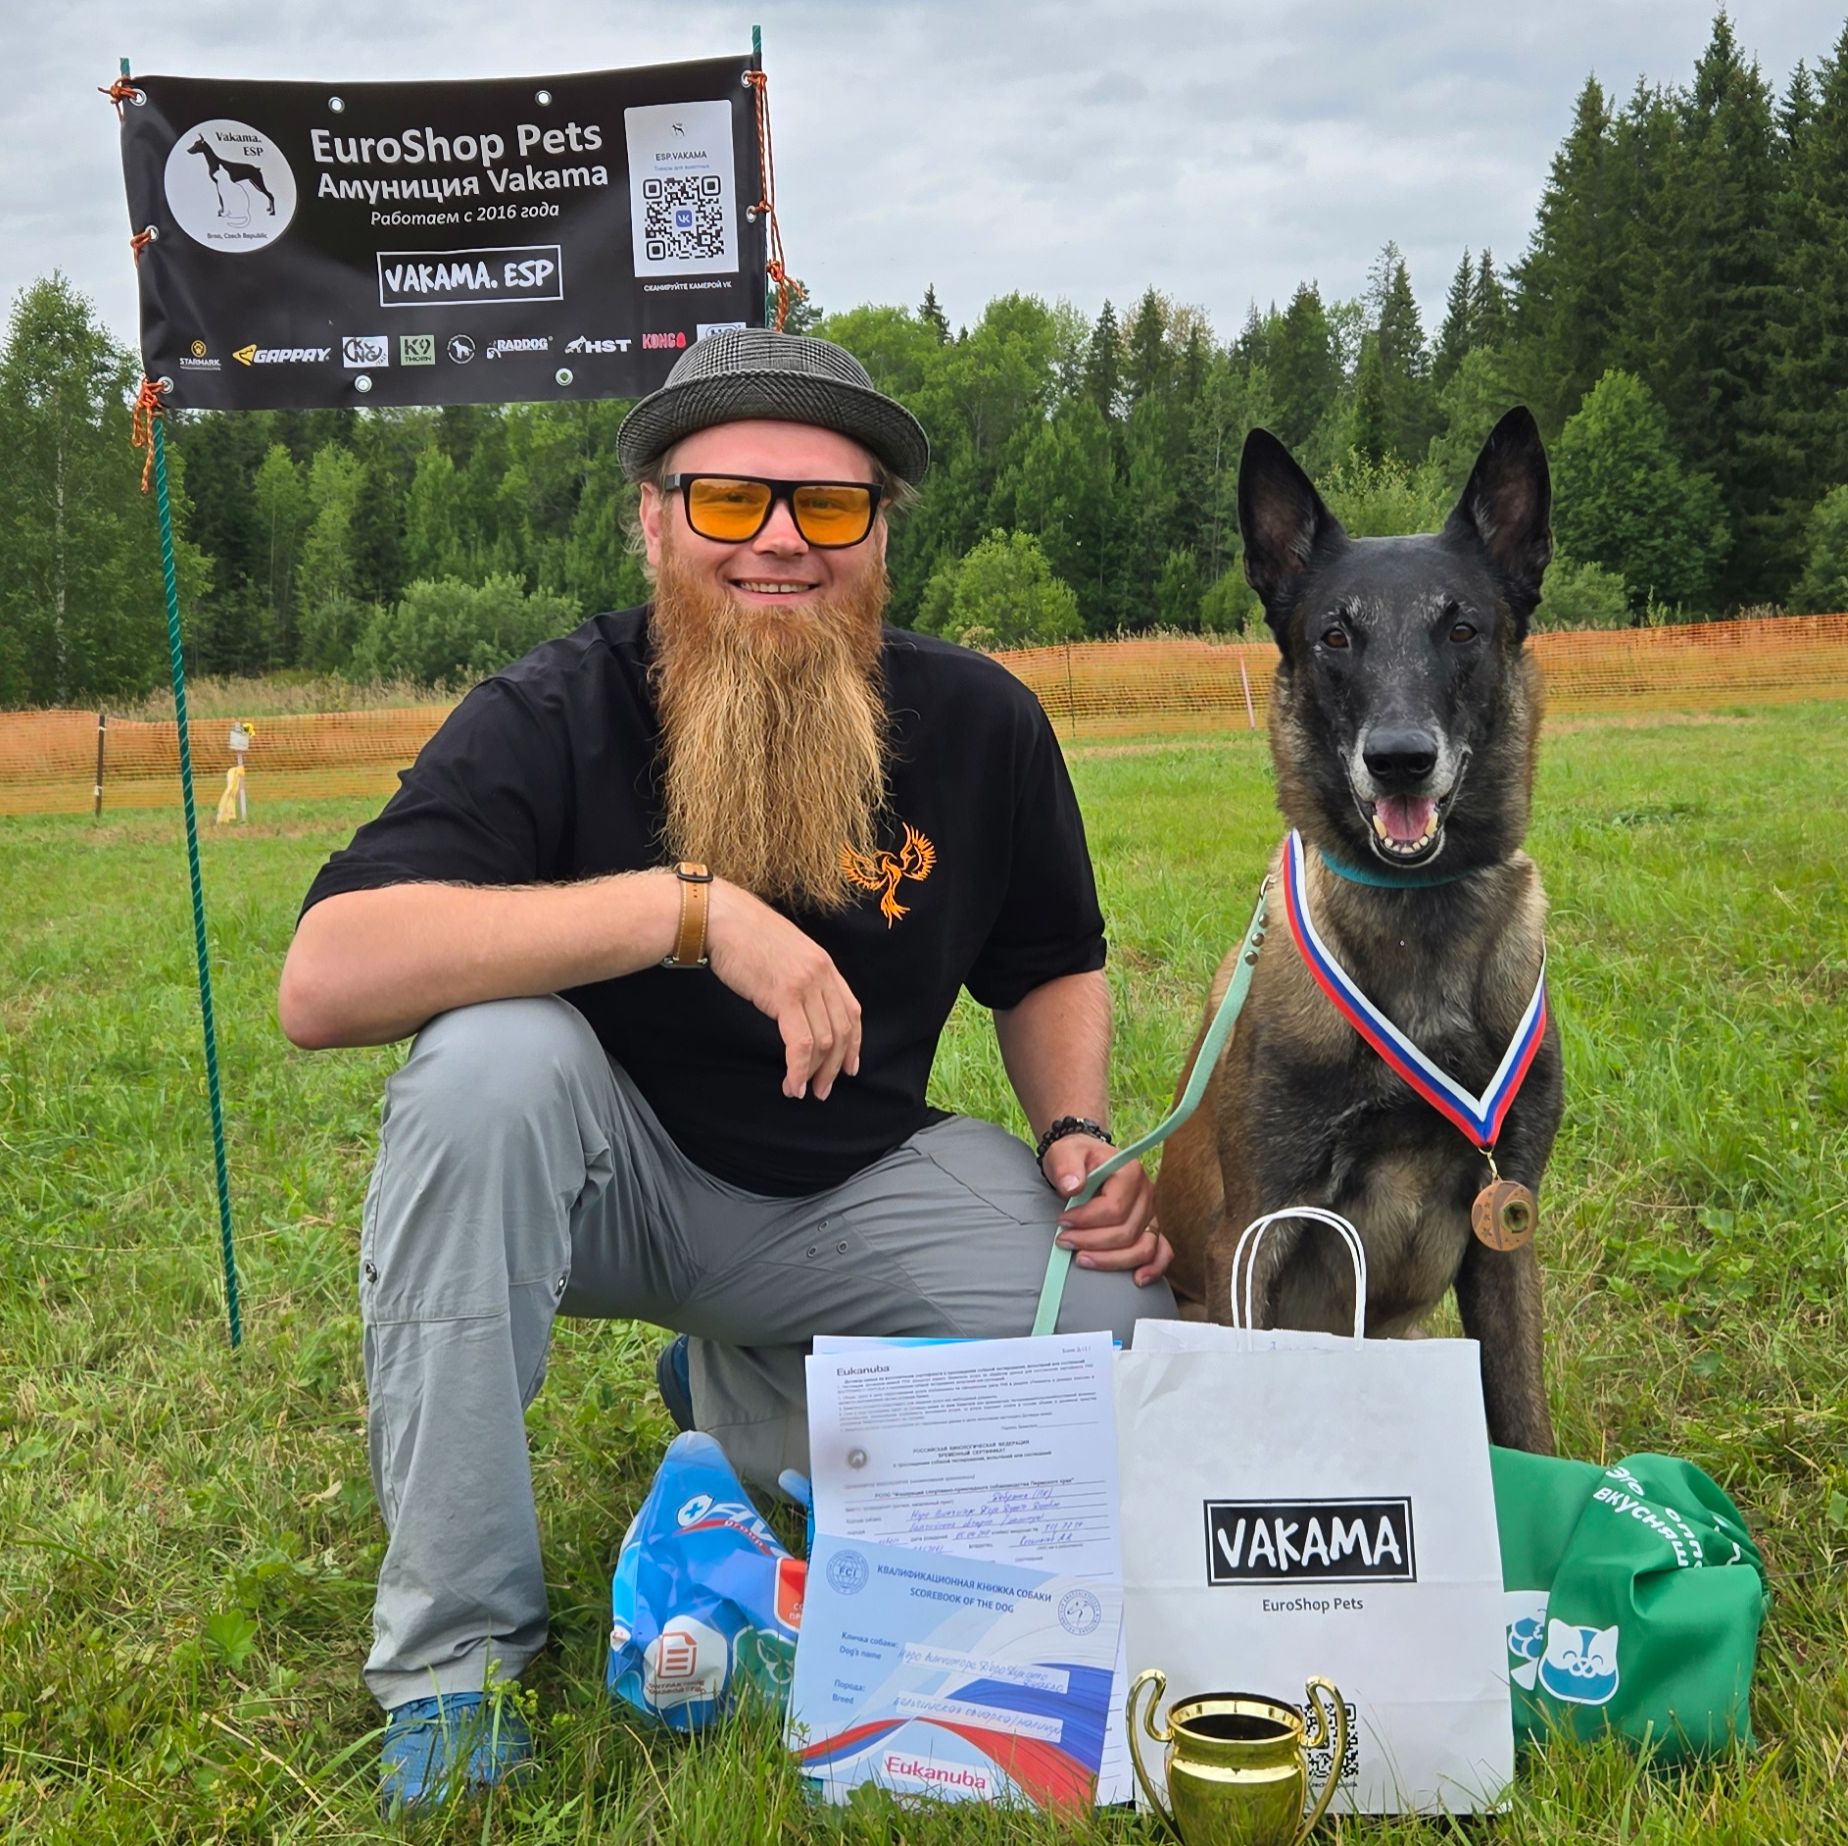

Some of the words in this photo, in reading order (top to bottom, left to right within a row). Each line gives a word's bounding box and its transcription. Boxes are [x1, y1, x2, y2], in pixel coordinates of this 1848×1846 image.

[215, 131, 262, 143] Vakama.
[310, 126, 505, 167] EuroShop
[516, 121, 603, 157] Pets
[243, 146, 264, 157] ESP
[655, 150, 708, 161] ESP.VAKAMA
[317, 172, 480, 205] Амуниция
[487, 164, 608, 193] Vakama
[370, 210, 460, 226] Работаем
[463, 211, 473, 223] с
[477, 204, 517, 222] 2016
[521, 201, 560, 219] года
[385, 261, 498, 293] VAKAMA.
[504, 259, 554, 288] ESP
[404, 339, 432, 355] K9
[585, 339, 632, 353] HST
[642, 332, 676, 350] KONG
[836, 1364, 890, 1377] Eukanuba
[1217, 1515, 1402, 1571] VAKAMA
[839, 1566, 857, 1577] FCI
[877, 1564, 976, 1589] КВАЛИФИКАЦИОННАЯ
[976, 1582, 1015, 1597] КНИЖКА
[1016, 1588, 1052, 1603] СОБАКИ
[910, 1586, 961, 1605] SCOREBOOK
[963, 1596, 975, 1606] OF
[976, 1598, 993, 1610] THE
[995, 1601, 1014, 1614] DOG
[1262, 1596, 1330, 1615] EuroShop
[1333, 1597, 1364, 1610] Pets
[832, 1693, 854, 1705] Breed
[887, 1755, 987, 1789] Eukanuba
